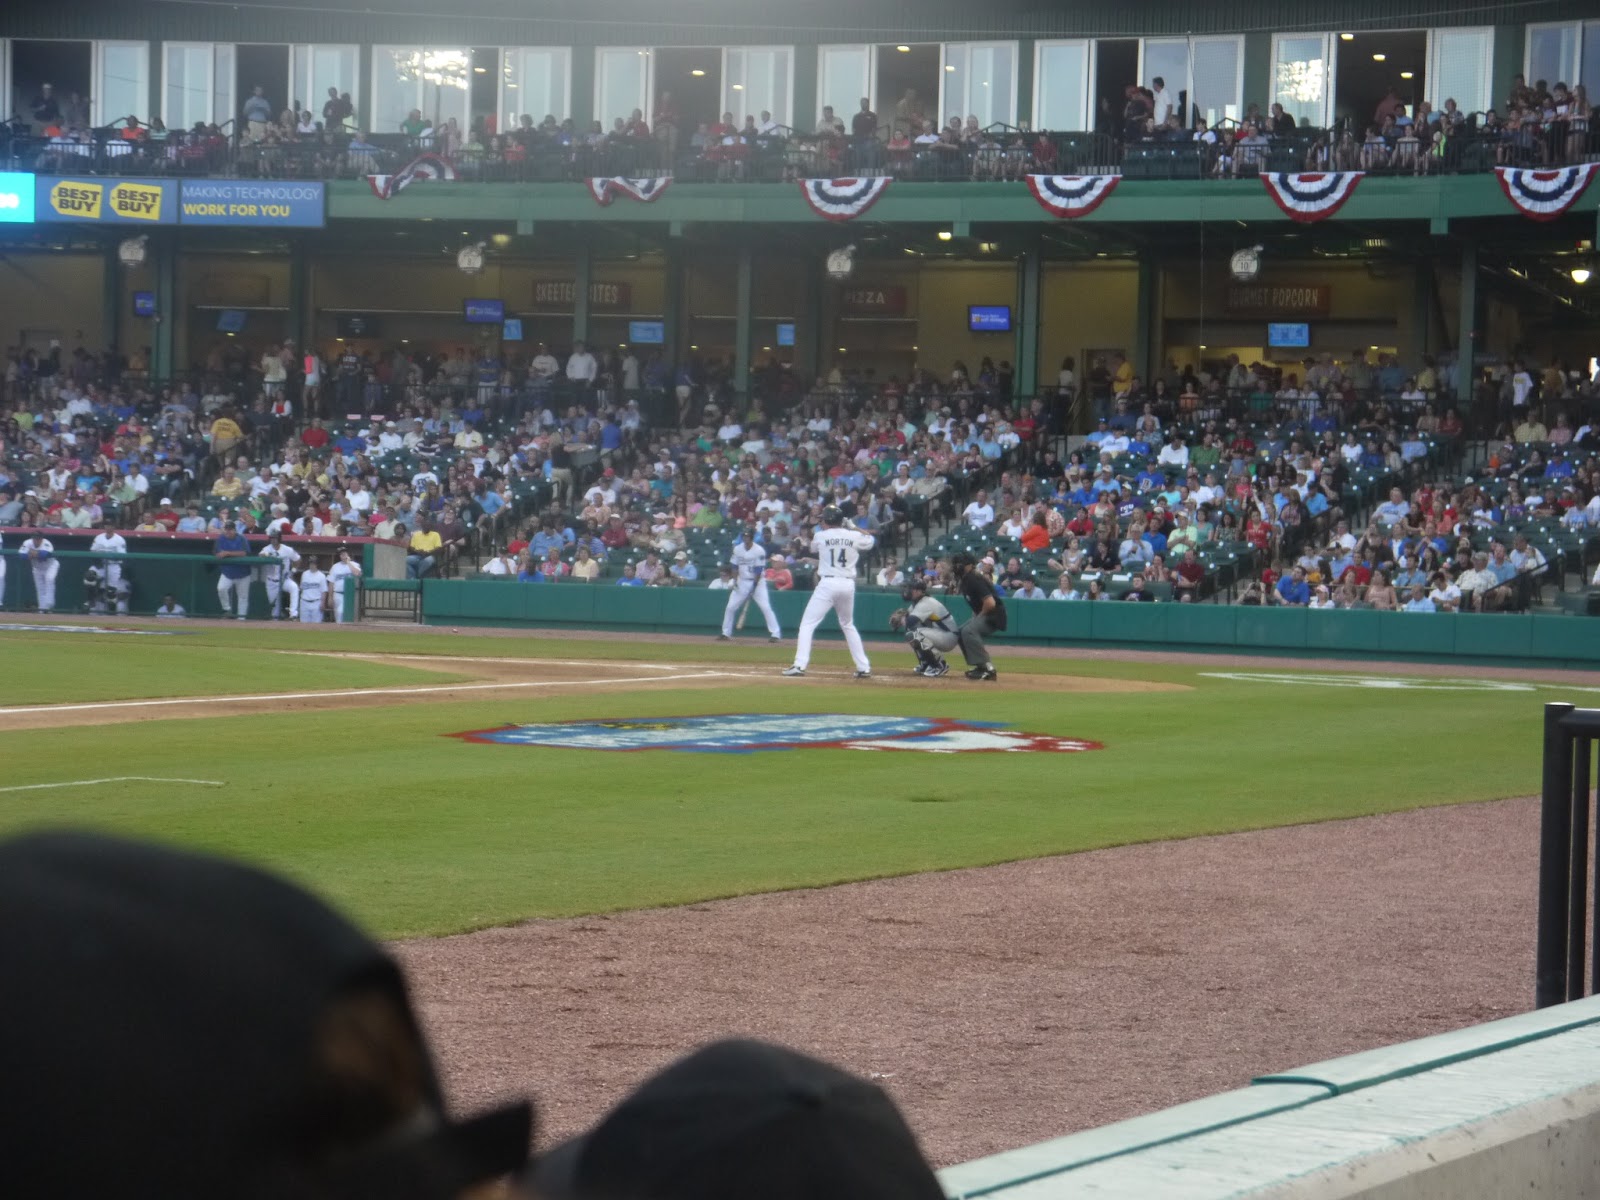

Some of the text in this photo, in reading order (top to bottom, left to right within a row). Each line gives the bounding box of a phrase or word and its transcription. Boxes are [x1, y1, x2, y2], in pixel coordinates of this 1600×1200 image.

[57, 186, 100, 202] BEST
[117, 188, 160, 204] BEST
[182, 186, 321, 200] MAKING TECHNOLOGY
[58, 198, 96, 212] BUY
[118, 200, 156, 214] BUY
[183, 203, 291, 217] WORK FOR YOU
[1240, 261, 1249, 270] 10
[1272, 287, 1319, 307] POPCORN
[829, 548, 847, 568] 14
